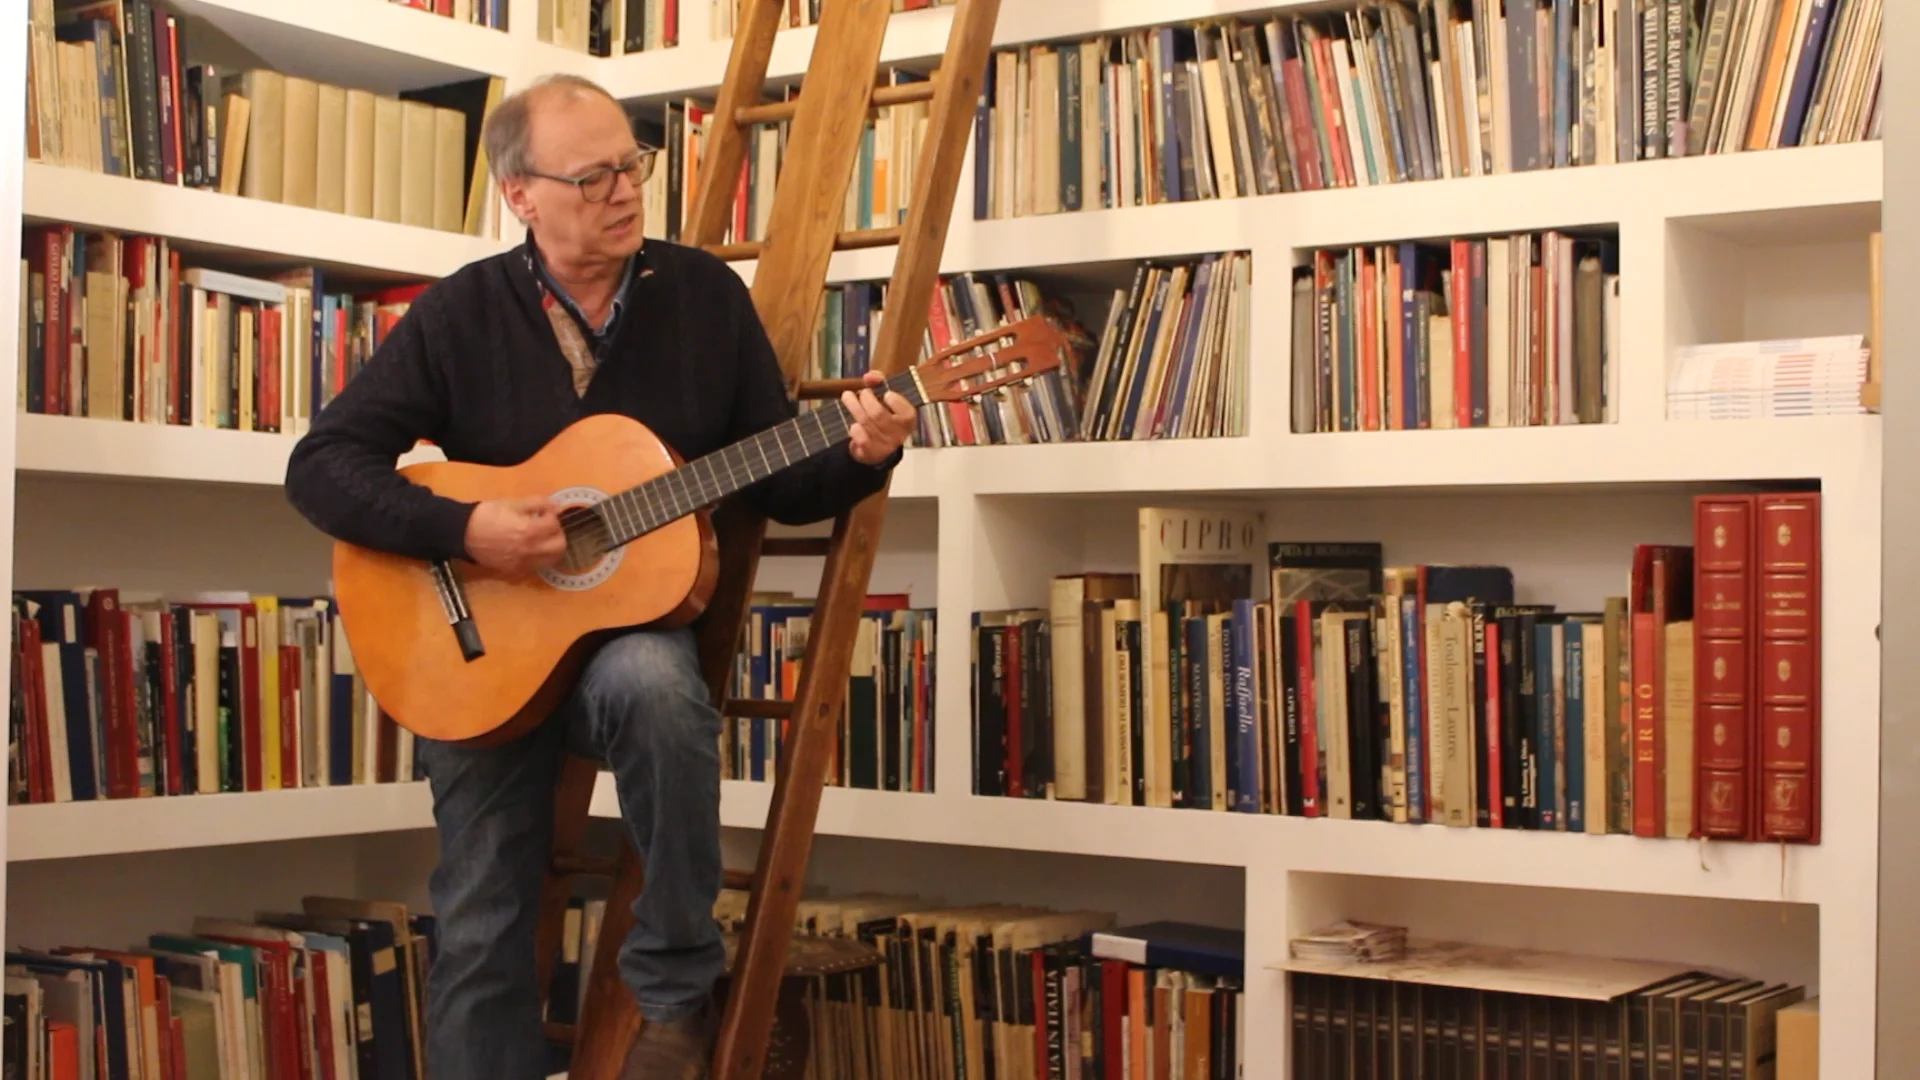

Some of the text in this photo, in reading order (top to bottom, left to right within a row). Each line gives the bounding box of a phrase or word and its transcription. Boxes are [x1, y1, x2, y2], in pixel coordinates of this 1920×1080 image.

[1644, 7, 1657, 135] WILLIAM MORRIS
[1160, 518, 1254, 550] CIPRO
[1223, 629, 1231, 668] DOSSO
[1192, 663, 1202, 729] MANTEGNA
[1236, 666, 1253, 733] Raffaello
[1287, 687, 1296, 743] CAPRAROLA
[1445, 634, 1459, 761] Toulouse-Lautrec
[1046, 970, 1058, 1025] ITALIA
